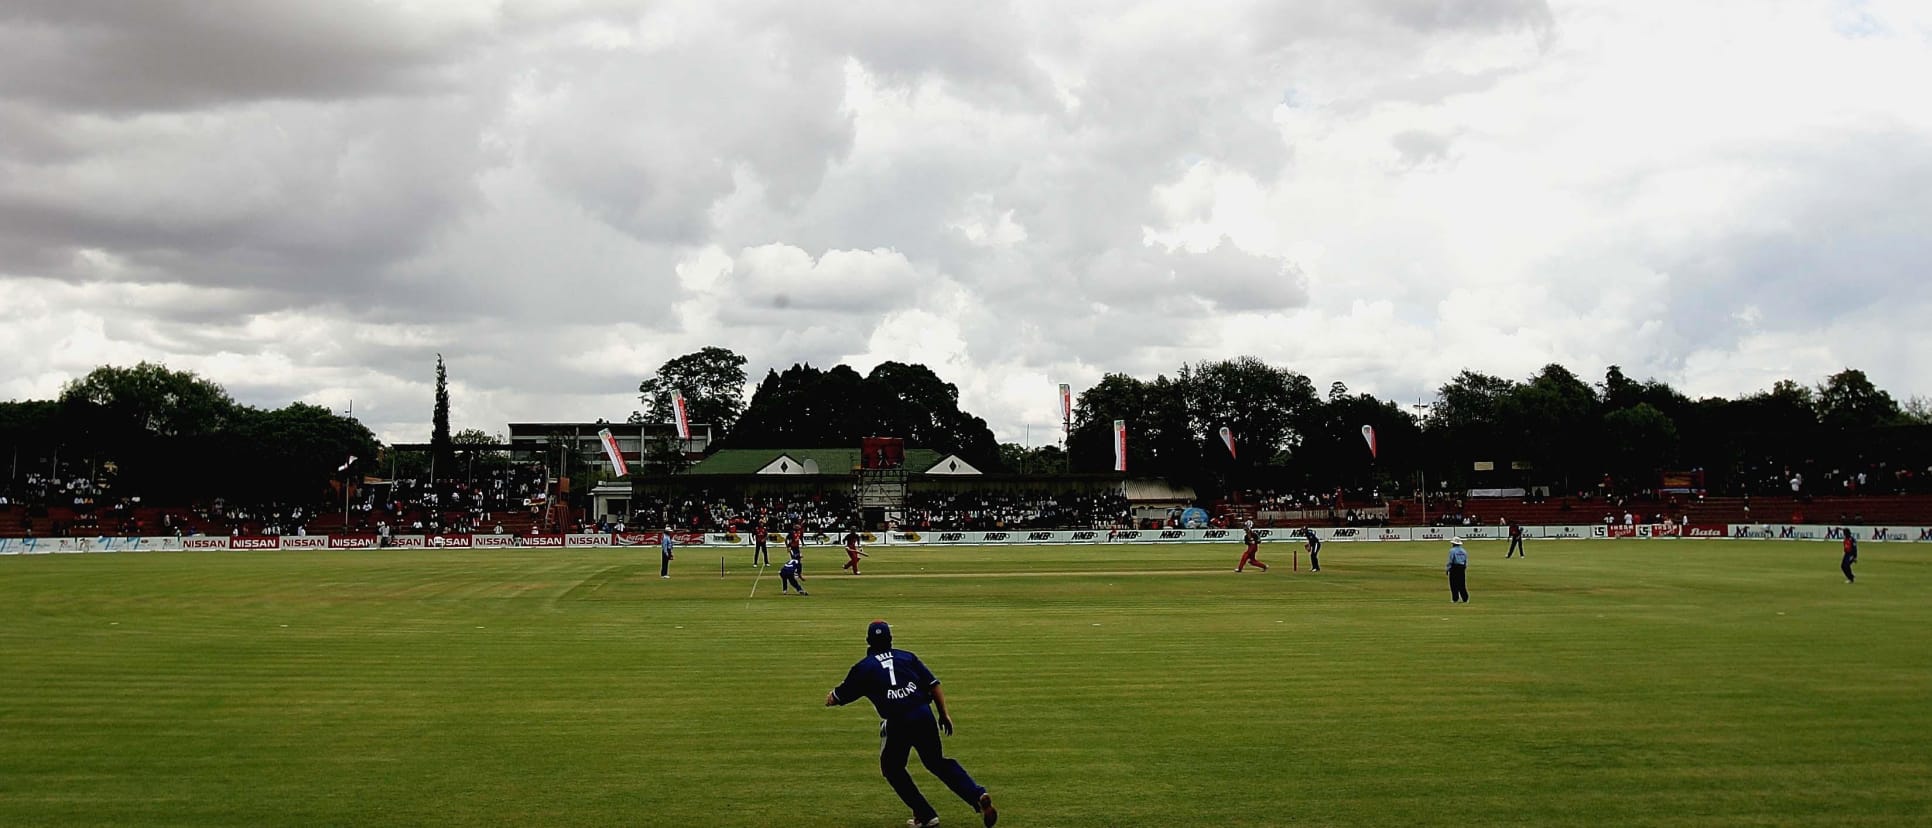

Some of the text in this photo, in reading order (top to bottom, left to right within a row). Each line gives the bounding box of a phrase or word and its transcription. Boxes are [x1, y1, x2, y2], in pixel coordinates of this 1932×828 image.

[1689, 527, 1721, 536] Bata
[183, 540, 226, 548] NISSAN
[233, 539, 276, 548] NISSAN
[283, 539, 325, 547] NISSAN
[331, 538, 374, 547] NISSAN
[428, 538, 469, 546] NSSAN
[522, 537, 562, 545] NISSAN
[568, 537, 608, 545] NISSAN
[875, 651, 894, 661] BELL
[880, 659, 897, 686] 7
